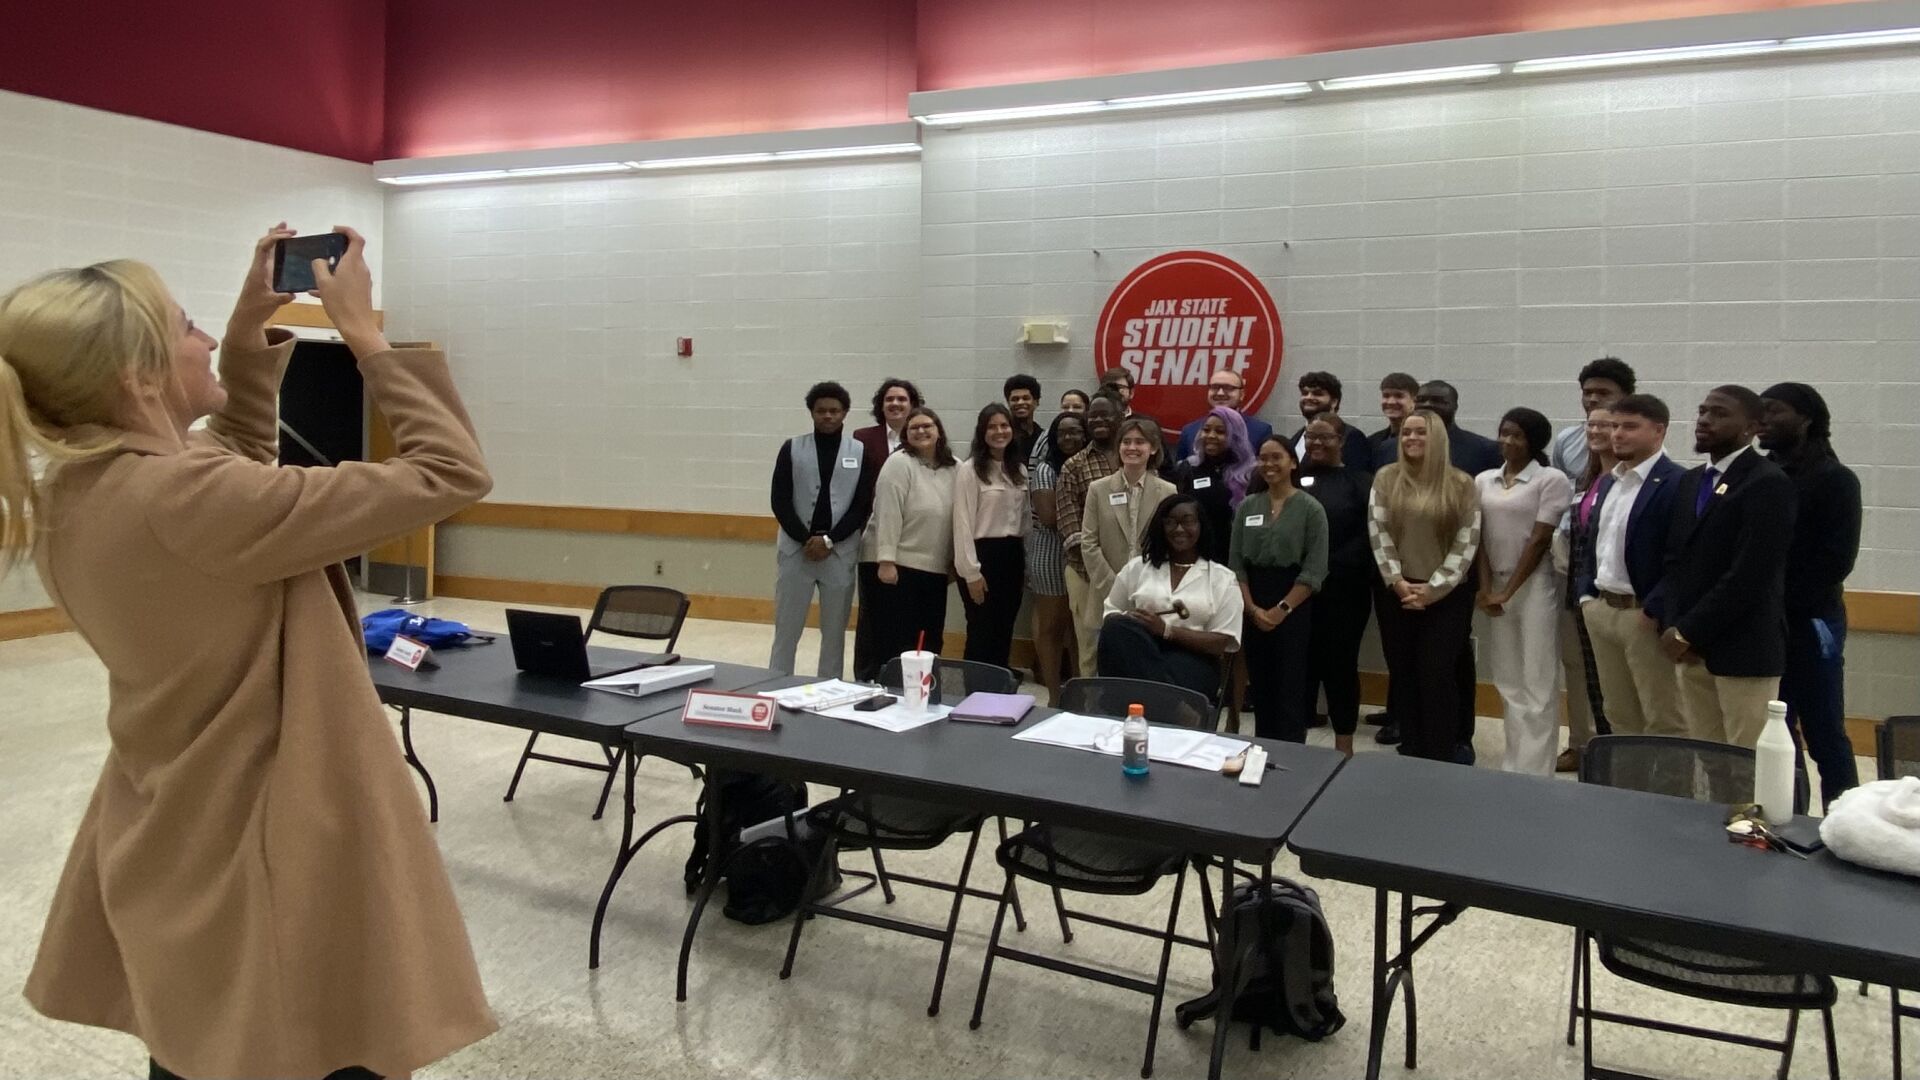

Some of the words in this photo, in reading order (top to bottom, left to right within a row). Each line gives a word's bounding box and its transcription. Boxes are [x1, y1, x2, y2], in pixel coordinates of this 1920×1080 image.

[1144, 299, 1178, 317] JAX
[1180, 297, 1232, 316] STATE
[1122, 316, 1258, 348] STUDENT
[1120, 348, 1253, 386] SENATE
[1135, 741, 1146, 754] G
